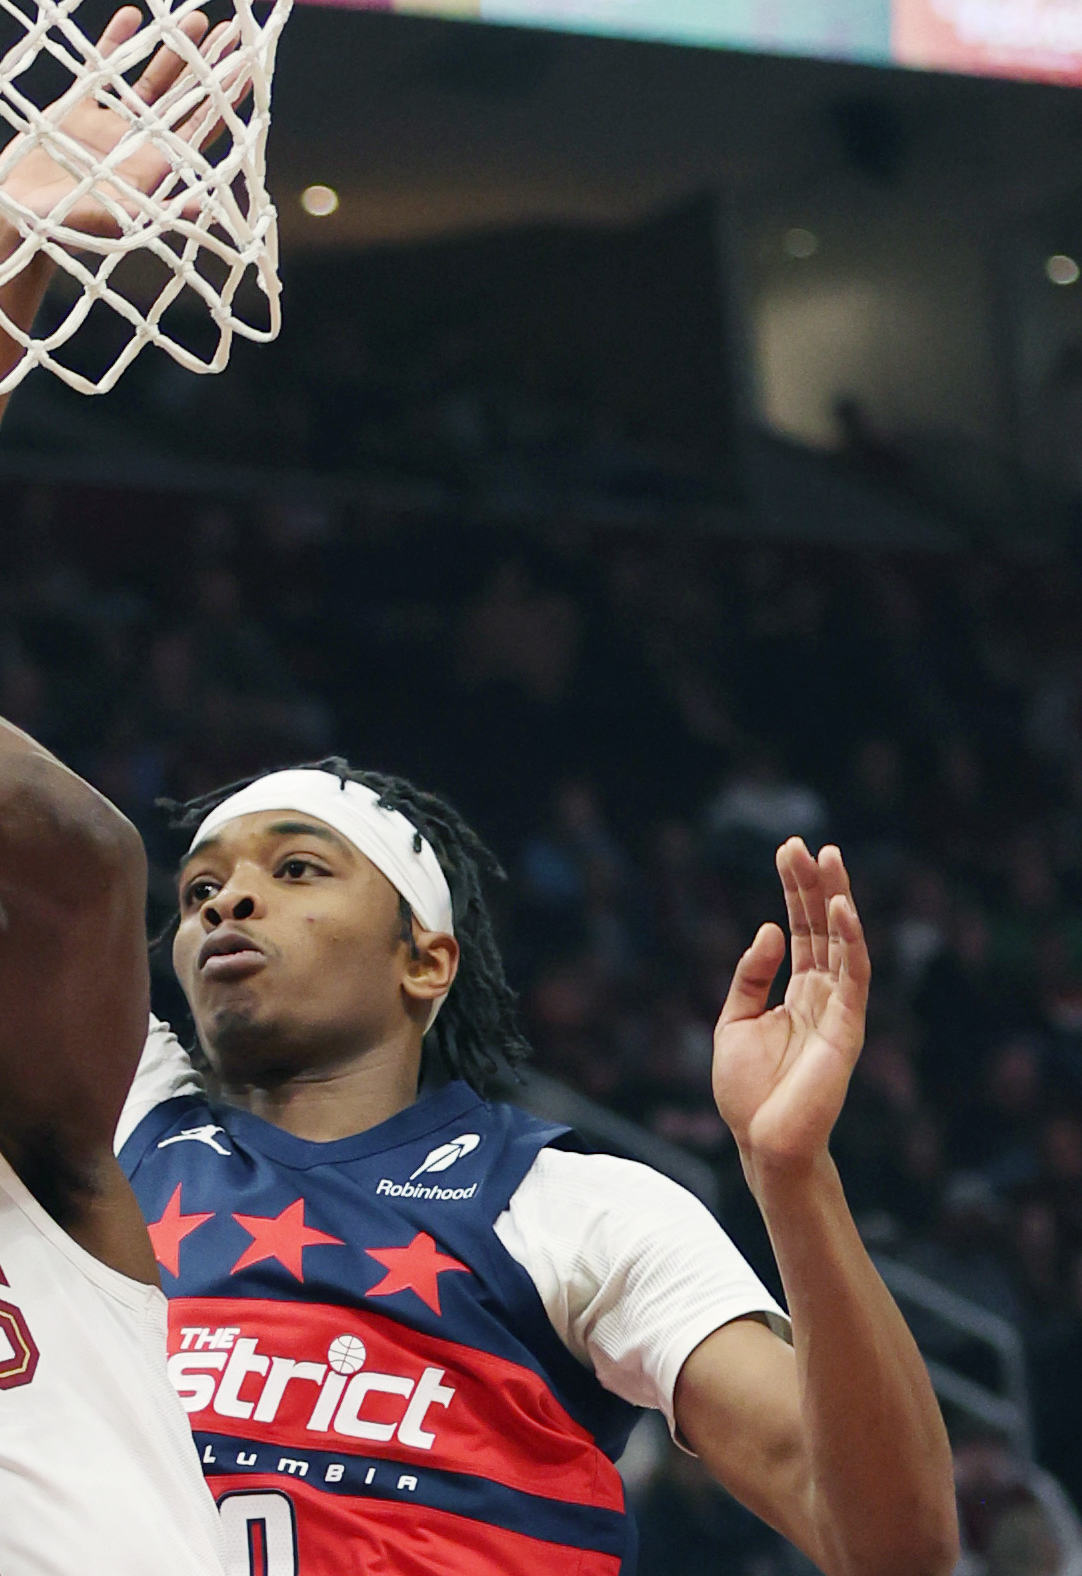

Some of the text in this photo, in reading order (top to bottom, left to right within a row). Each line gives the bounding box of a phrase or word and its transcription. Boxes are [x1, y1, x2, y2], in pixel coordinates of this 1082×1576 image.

[376, 1179, 478, 1200] Robinhood
[180, 1326, 241, 1350] THE
[167, 1334, 456, 1450] strict
